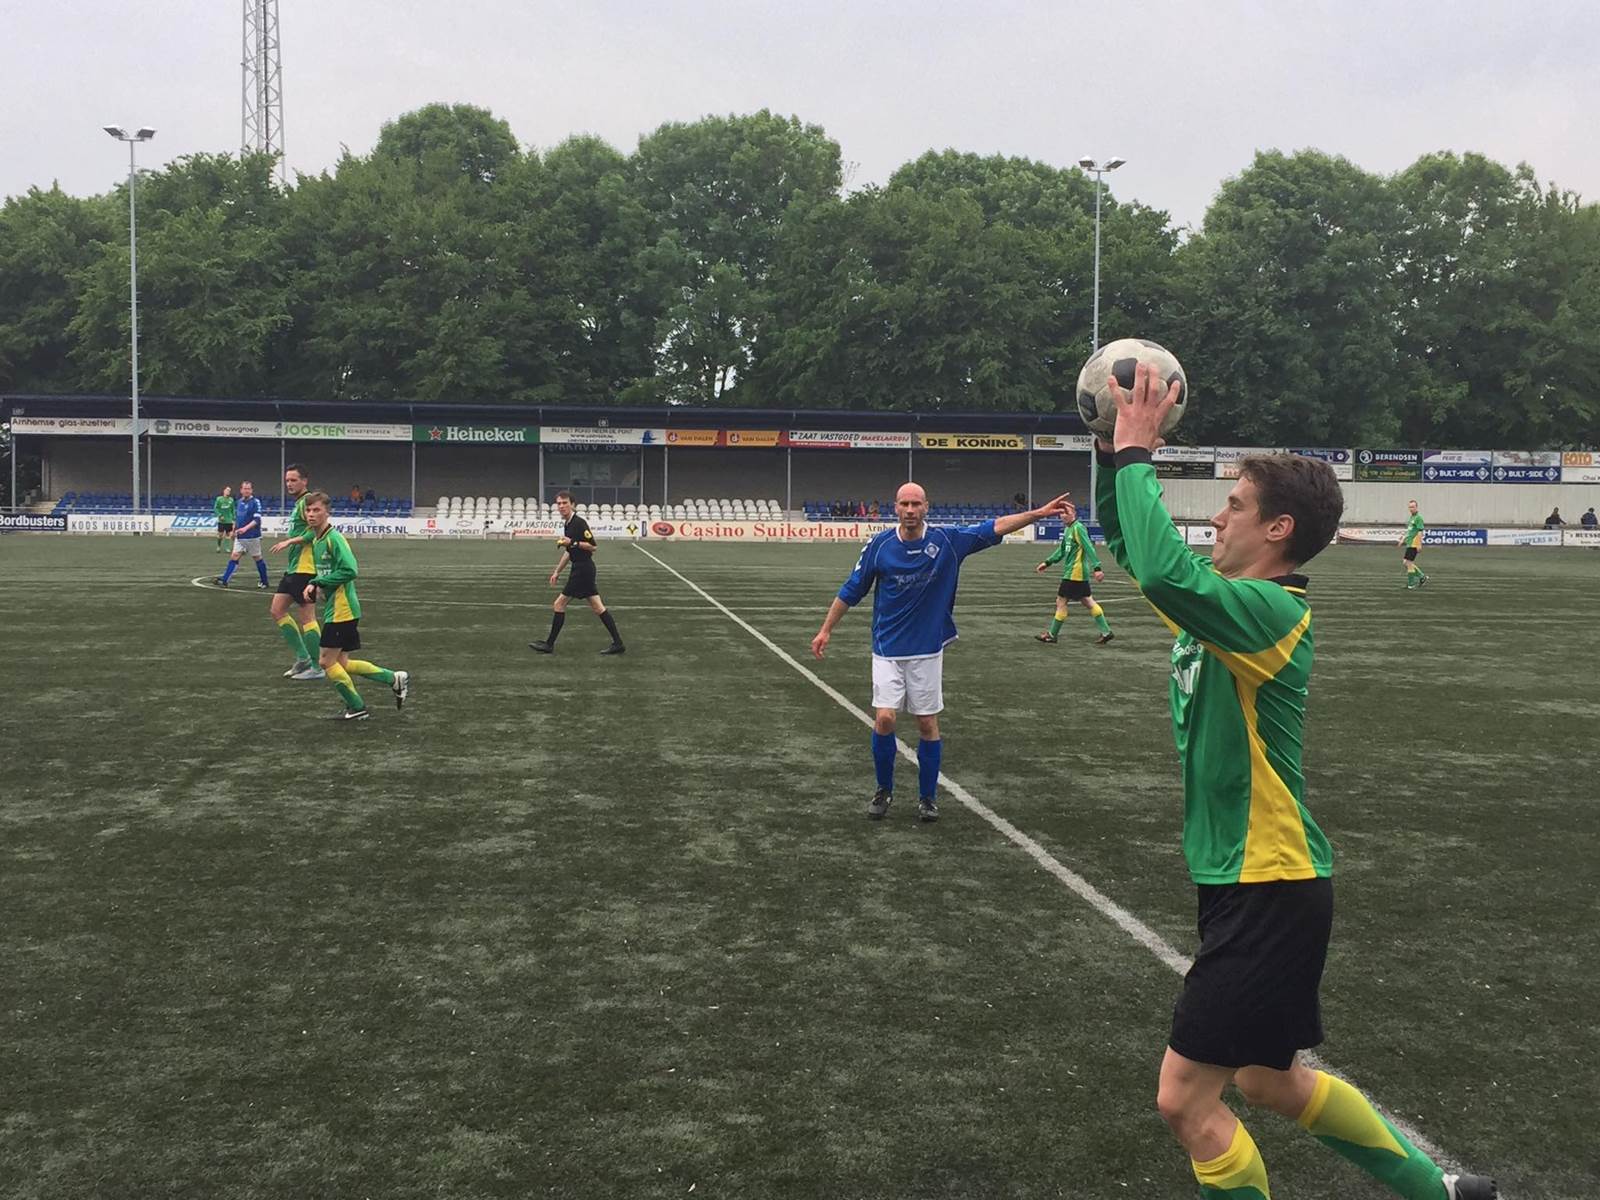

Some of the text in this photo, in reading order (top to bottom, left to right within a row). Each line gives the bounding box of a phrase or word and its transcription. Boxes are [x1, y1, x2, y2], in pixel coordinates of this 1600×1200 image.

[175, 422, 260, 434] moes bouwgroep
[284, 423, 346, 437] JOOSTEN
[446, 426, 525, 442] Heineken
[799, 432, 817, 440] ZAAT
[820, 433, 860, 441] VASTGOED
[926, 438, 1019, 448] DE KONING
[1375, 453, 1418, 461] BERENDSEN
[0, 515, 65, 528] Bordbusters
[71, 521, 150, 530] KOOS HUBERTS
[174, 516, 218, 526] REKA
[504, 520, 565, 529] ZAAT VASTGOED
[333, 525, 409, 534] W.BULTERS.NL
[679, 523, 745, 537] Casino
[753, 523, 859, 538] Suikerland
[1422, 529, 1477, 537] Haarmode
